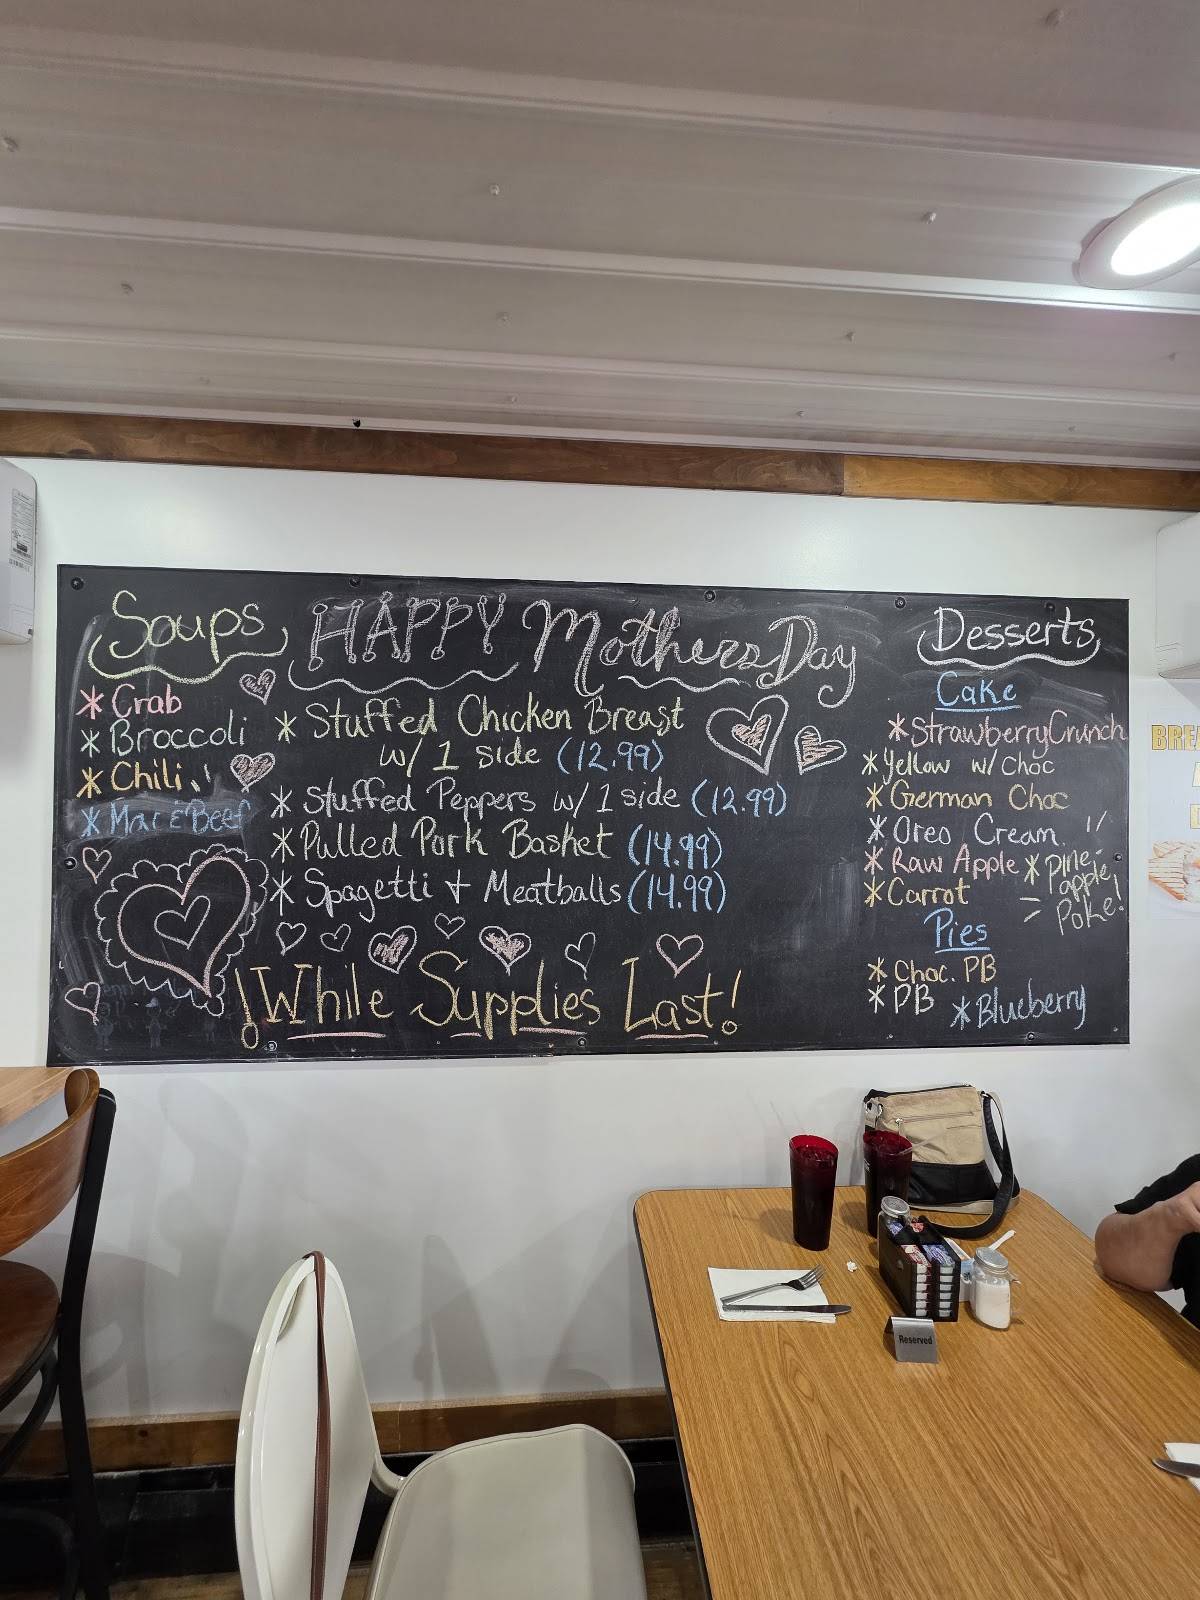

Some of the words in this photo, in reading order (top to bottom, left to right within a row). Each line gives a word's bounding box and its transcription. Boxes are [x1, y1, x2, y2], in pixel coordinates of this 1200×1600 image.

[109, 590, 265, 663] Soups
[932, 606, 1095, 651] Desserts
[308, 590, 507, 672] HAPPY
[755, 615, 857, 707] Day
[111, 684, 183, 719] Crab
[305, 697, 438, 739] Stuffed
[458, 692, 573, 736] Chicken
[584, 696, 685, 736] Breast
[110, 709, 247, 757] Broccoli
[111, 758, 183, 793] Chili
[379, 738, 423, 777] w/
[432, 741, 460, 770] 1
[477, 737, 540, 768] side
[557, 737, 665, 775] (12.99)
[883, 748, 950, 785] Yellow
[972, 749, 997, 775] w/
[1001, 752, 1056, 776] Choc
[303, 777, 417, 817] Stuffed
[427, 776, 537, 822] Peppers
[553, 772, 591, 818] w/
[597, 785, 613, 812] 1
[621, 776, 681, 810] side
[691, 781, 787, 817] (12.99)
[890, 779, 992, 810] German
[1008, 783, 1071, 810] Choc
[300, 816, 404, 862] Pulled
[411, 817, 489, 858] Pork
[502, 818, 613, 859] Basket
[628, 824, 723, 869] (14.99)
[893, 815, 951, 845] Oreo
[892, 846, 943, 874] Raw
[953, 843, 1020, 881] Apple
[304, 868, 434, 923] Spagetti
[484, 869, 623, 905] Meatballs
[627, 870, 727, 914] (14.99)
[887, 877, 971, 907] Carrot
[924, 907, 988, 948] Pies
[894, 959, 955, 985] Choc.
[964, 954, 997, 983] PB
[410, 950, 600, 1040] Supplies
[622, 956, 744, 1034] Last!
[893, 983, 934, 1015] PB
[976, 977, 1087, 1030] Blueberry
[898, 1334, 933, 1346] Reserved
